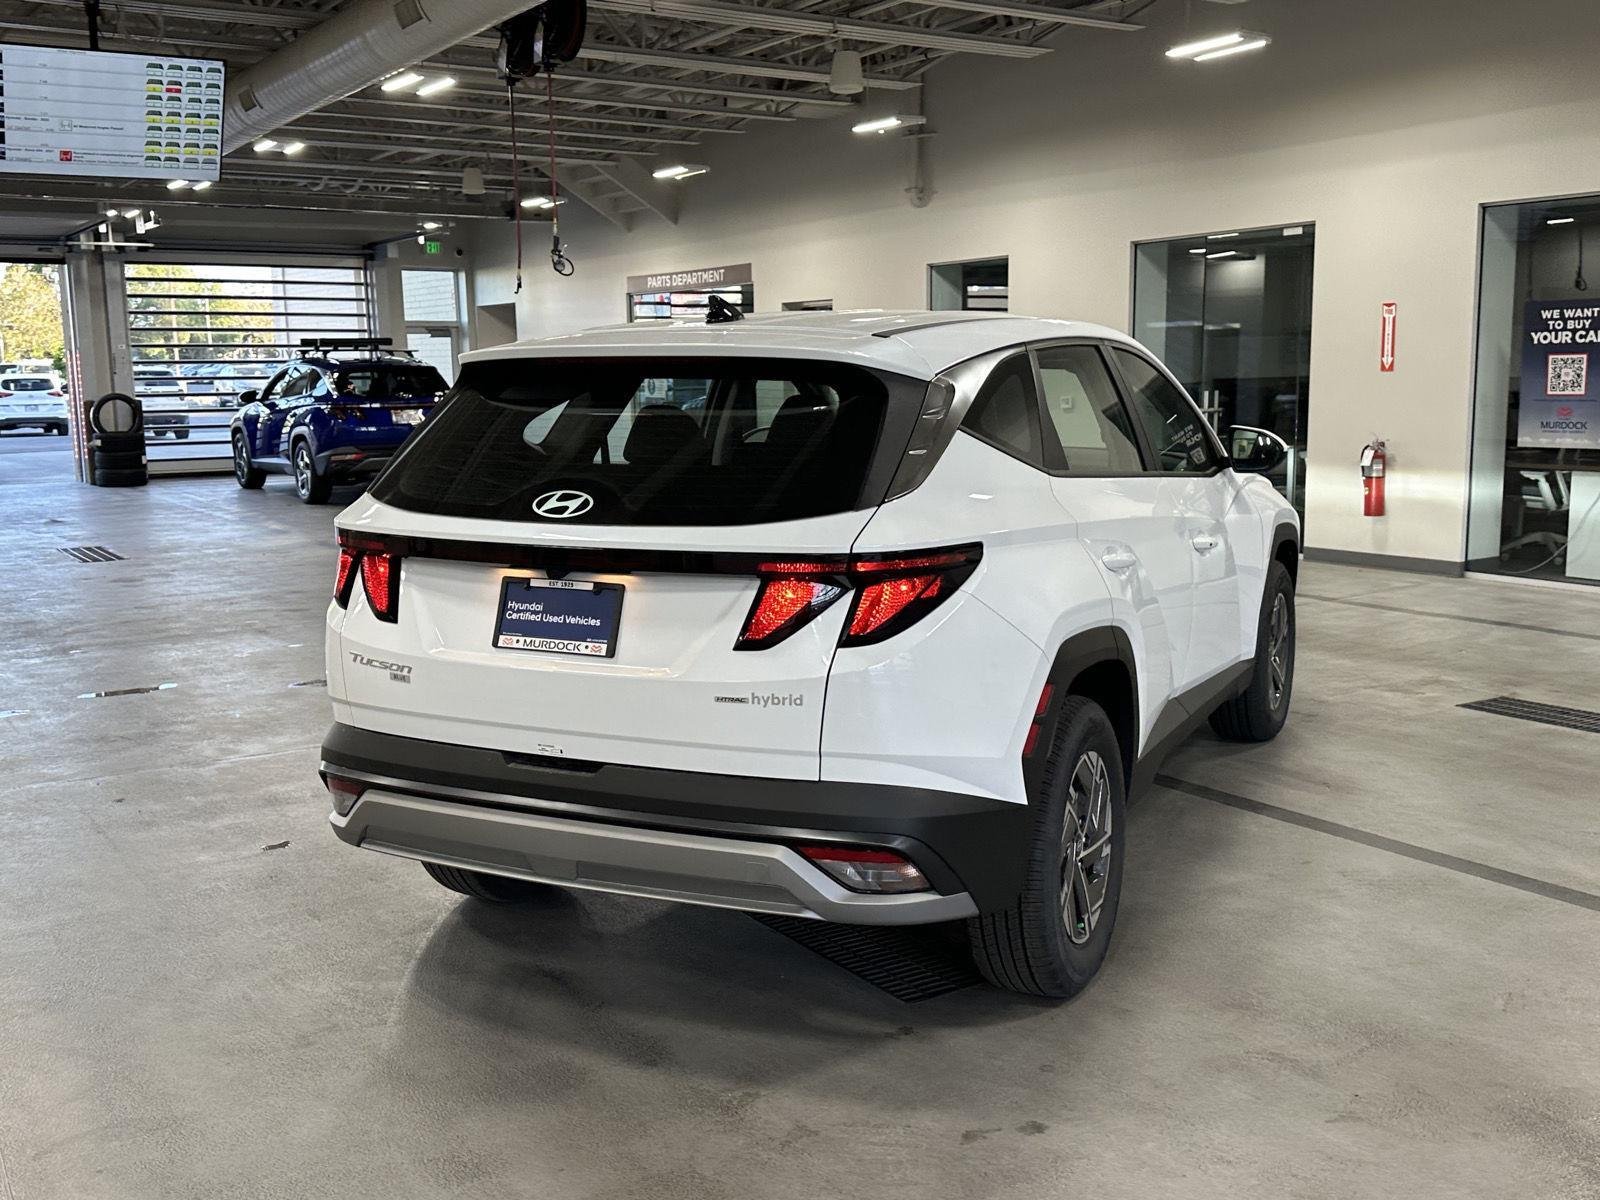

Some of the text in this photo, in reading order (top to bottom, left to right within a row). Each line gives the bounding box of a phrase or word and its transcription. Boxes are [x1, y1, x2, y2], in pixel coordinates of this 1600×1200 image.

[647, 269, 725, 288] PARTS DEPARTMENT
[1541, 307, 1600, 319] WE WANT
[1547, 319, 1592, 330] TO BUY
[1531, 331, 1573, 344] YOUR
[1540, 421, 1588, 430] MURDOCK
[507, 601, 544, 612] Hyundai
[506, 610, 601, 626] Certified Used Vehicles
[522, 638, 581, 652] MURDOCK
[715, 692, 803, 708] HTRAC hybrid
